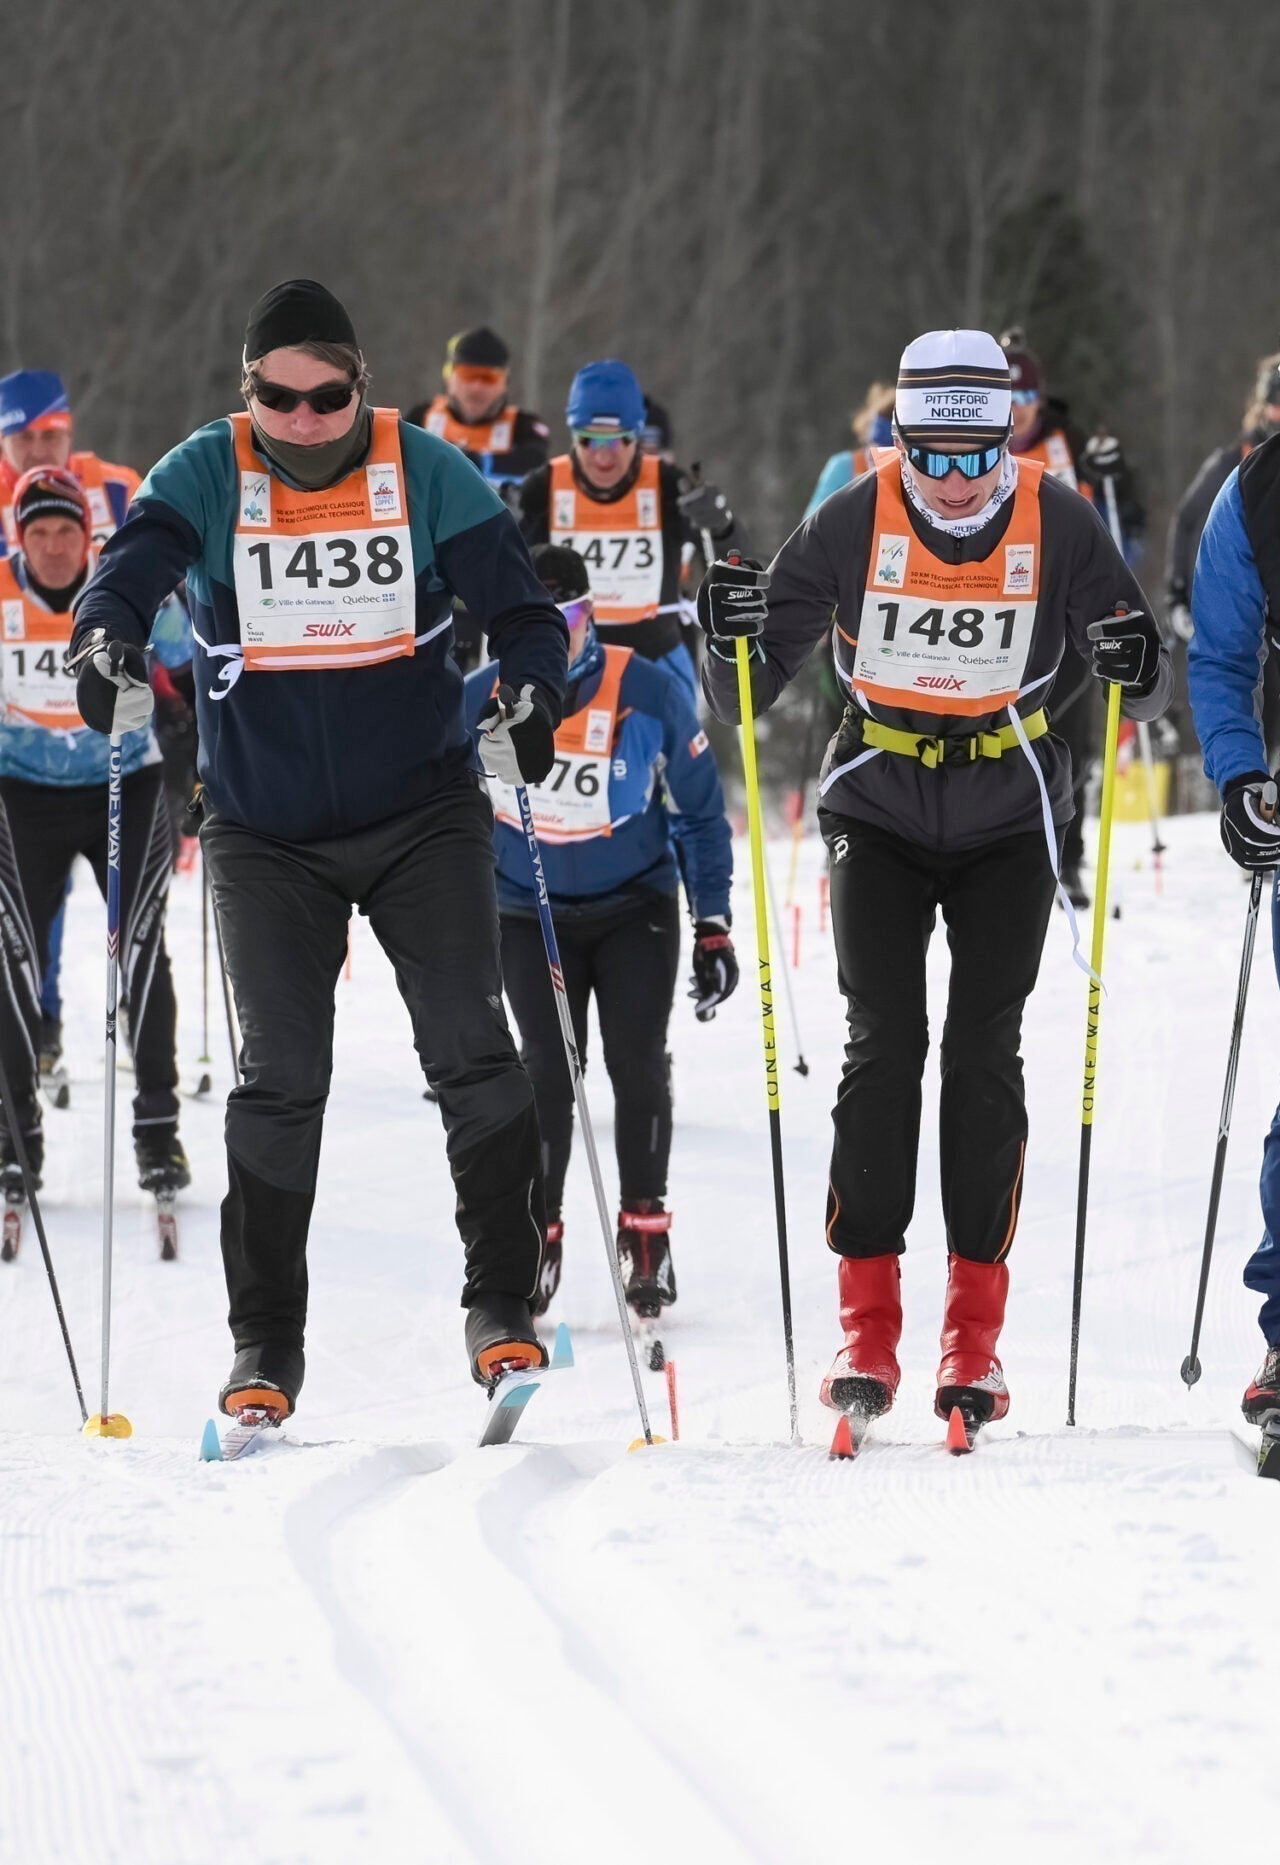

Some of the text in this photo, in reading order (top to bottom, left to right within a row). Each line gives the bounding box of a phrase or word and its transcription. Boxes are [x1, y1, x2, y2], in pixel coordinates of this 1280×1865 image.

[925, 394, 988, 404] PITTSFORD
[931, 408, 982, 418] NORDIC
[296, 504, 328, 514] TECHNIQUE
[330, 500, 365, 510] CLASSIQUE
[296, 513, 327, 522] CLASSICAL
[329, 510, 365, 518] TECHNIQUE
[247, 535, 403, 590] 1438
[931, 574, 964, 582] TECHNIQUE
[930, 581, 962, 589] CLASSICAL
[342, 594, 380, 606] Québec
[878, 602, 1016, 649] 1481
[12, 648, 78, 678] 148
[922, 652, 950, 662] Gatineau
[958, 654, 994, 665] Québec
[534, 758, 600, 797] 76
